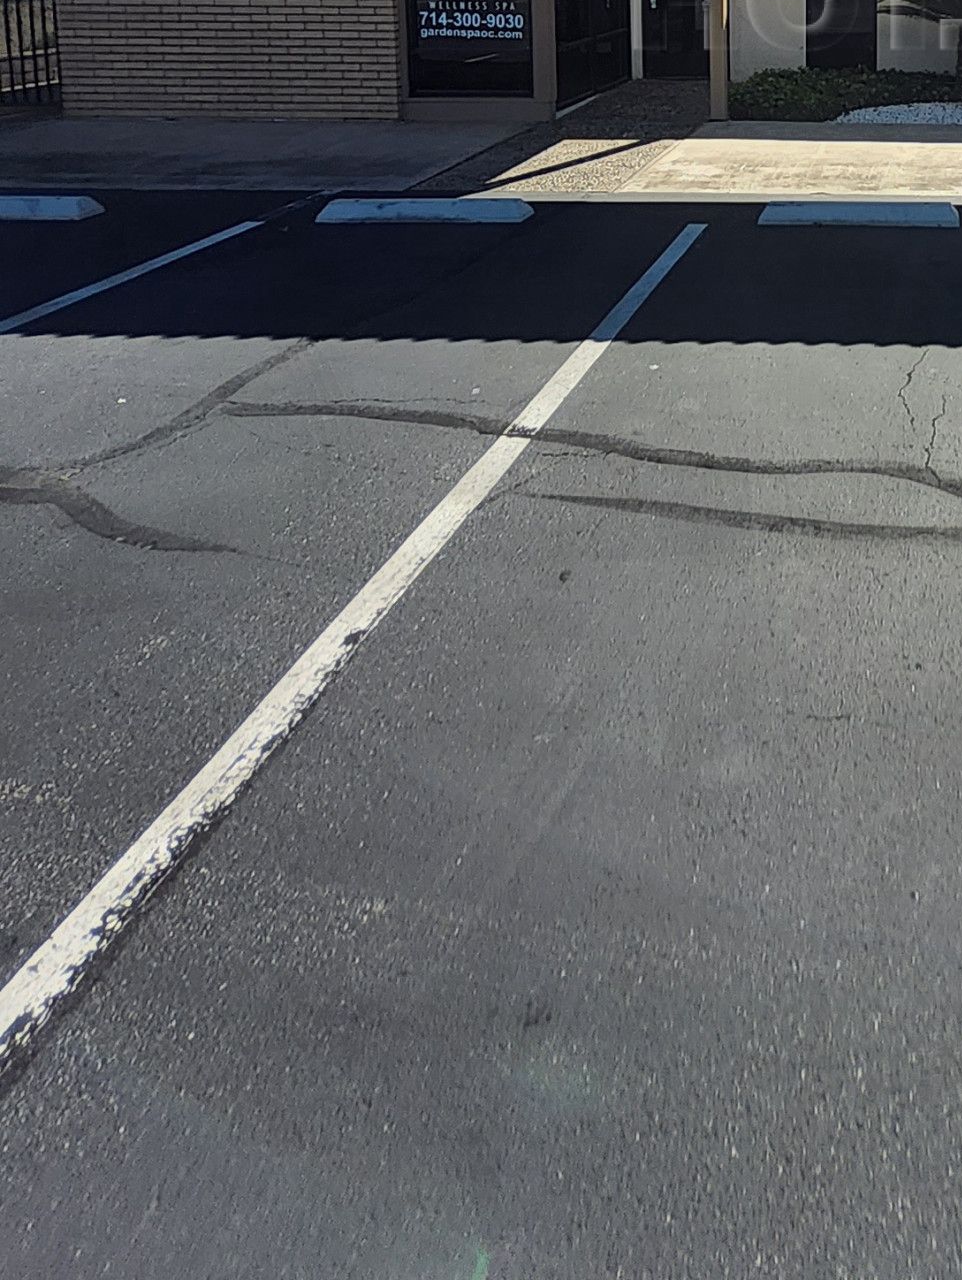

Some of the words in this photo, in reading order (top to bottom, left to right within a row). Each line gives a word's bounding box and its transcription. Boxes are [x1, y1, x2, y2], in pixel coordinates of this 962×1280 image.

[428, 1, 488, 10] WELLNESS
[495, 1, 516, 10] SPA
[418, 11, 524, 29] 714-300-9030
[420, 28, 523, 40] gardenspaoc.com
